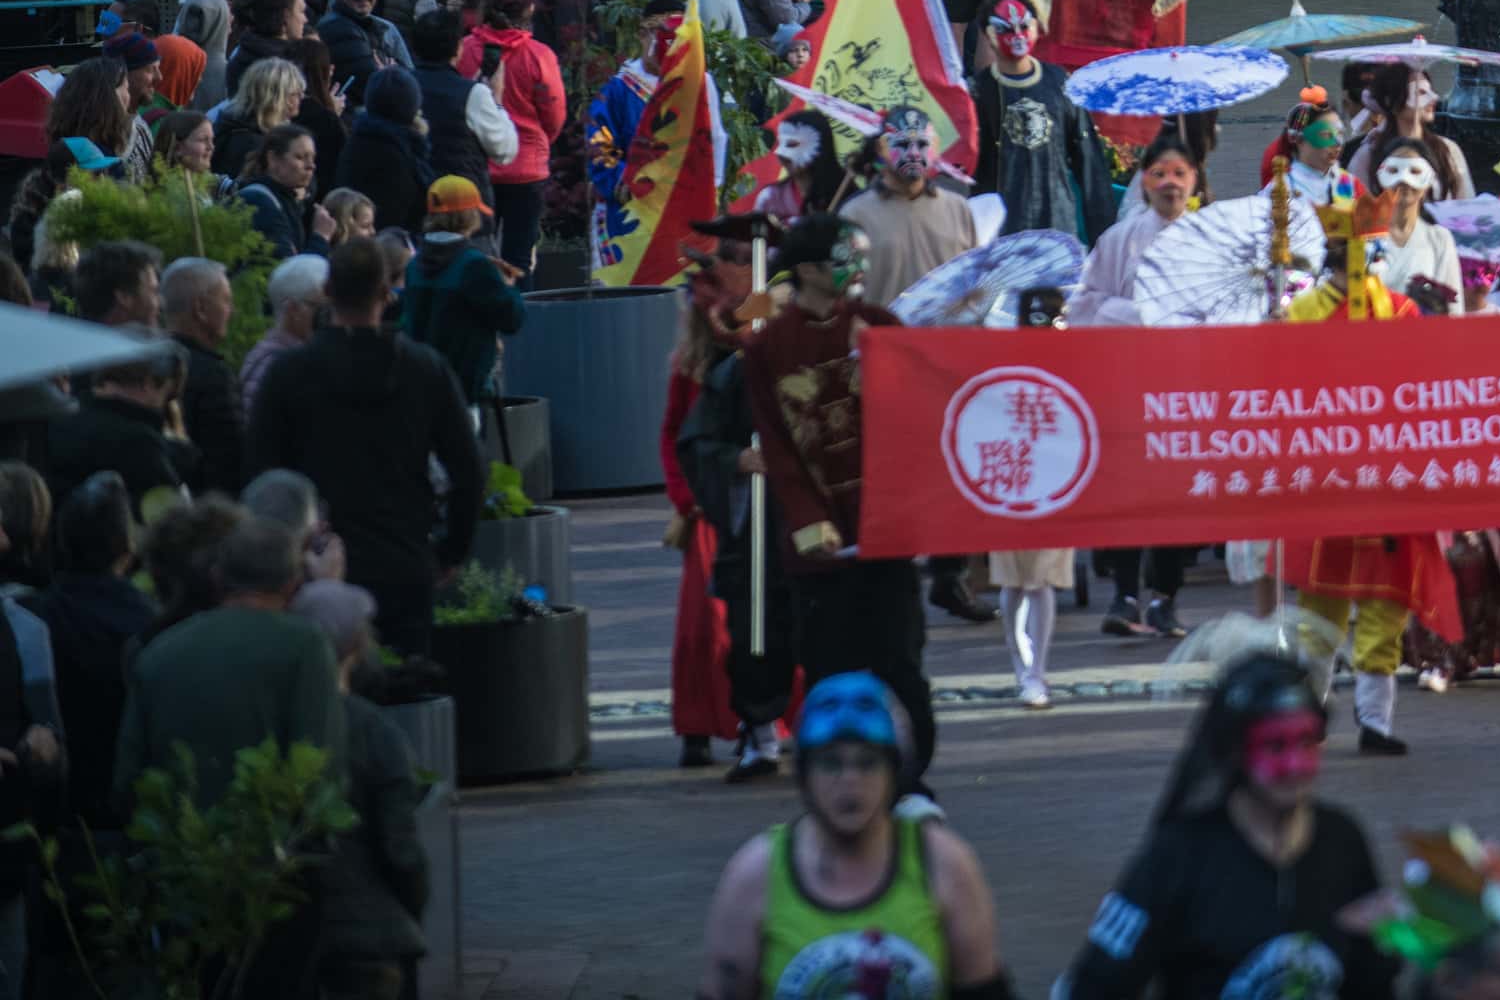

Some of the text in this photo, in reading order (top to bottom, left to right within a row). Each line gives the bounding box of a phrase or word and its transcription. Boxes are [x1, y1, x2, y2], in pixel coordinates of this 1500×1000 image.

[1143, 391, 1219, 422] NEW
[1228, 384, 1386, 421] ZEALAND
[1145, 428, 1281, 461] NELSON
[1288, 424, 1361, 456] AND
